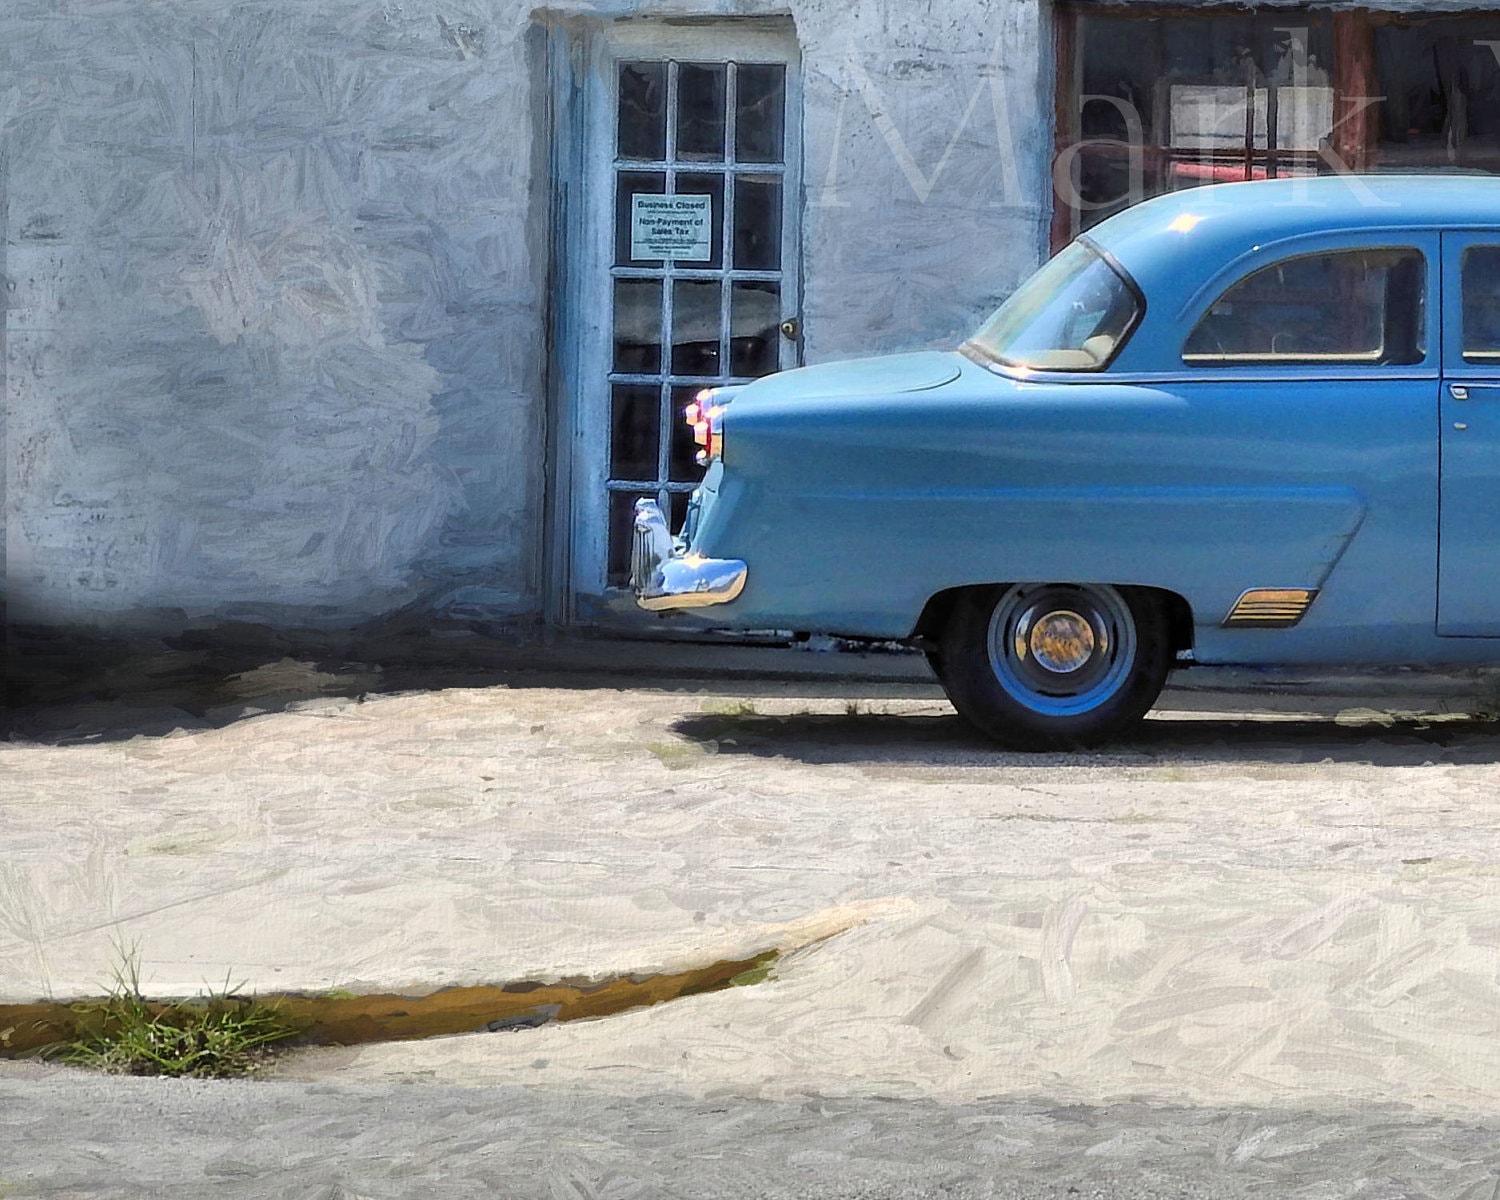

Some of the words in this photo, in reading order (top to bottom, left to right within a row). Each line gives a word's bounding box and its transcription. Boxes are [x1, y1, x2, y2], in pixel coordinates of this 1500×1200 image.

[637, 200, 673, 210] Business
[675, 201, 706, 210] Closed
[694, 218, 704, 226] of
[651, 227, 673, 235] Sales
[674, 227, 690, 235] Tax
